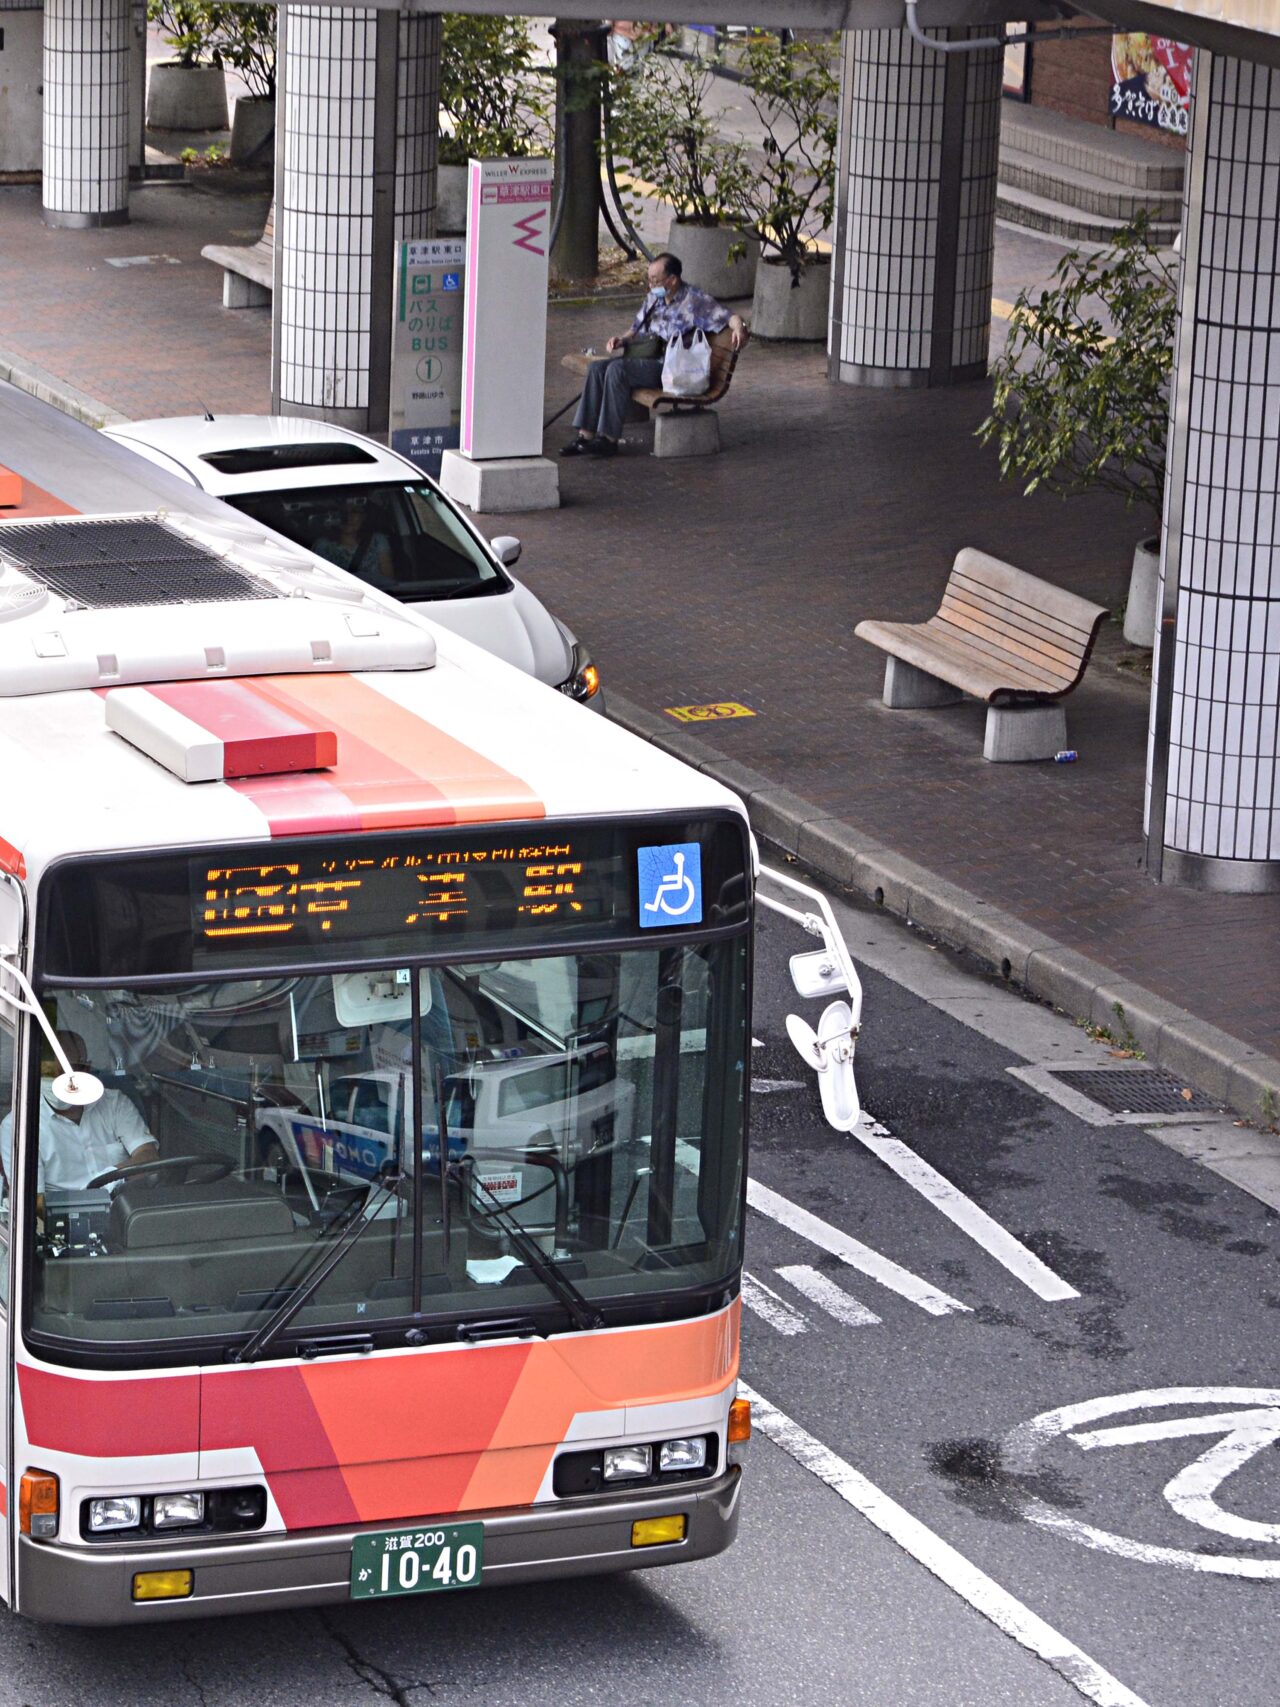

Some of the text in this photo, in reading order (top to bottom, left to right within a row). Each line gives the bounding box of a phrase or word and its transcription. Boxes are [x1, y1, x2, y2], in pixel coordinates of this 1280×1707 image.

[520, 167, 548, 176] EXPRESS
[499, 183, 550, 197] 草津駅東口
[410, 245, 462, 256] 草津駅東口
[409, 300, 439, 313] バス
[408, 315, 454, 333] のりば
[412, 336, 449, 351] BUS
[410, 434, 443, 446] 草津市
[384, 1531, 446, 1551] 滋賀200
[358, 1544, 477, 1592] か 10-40
